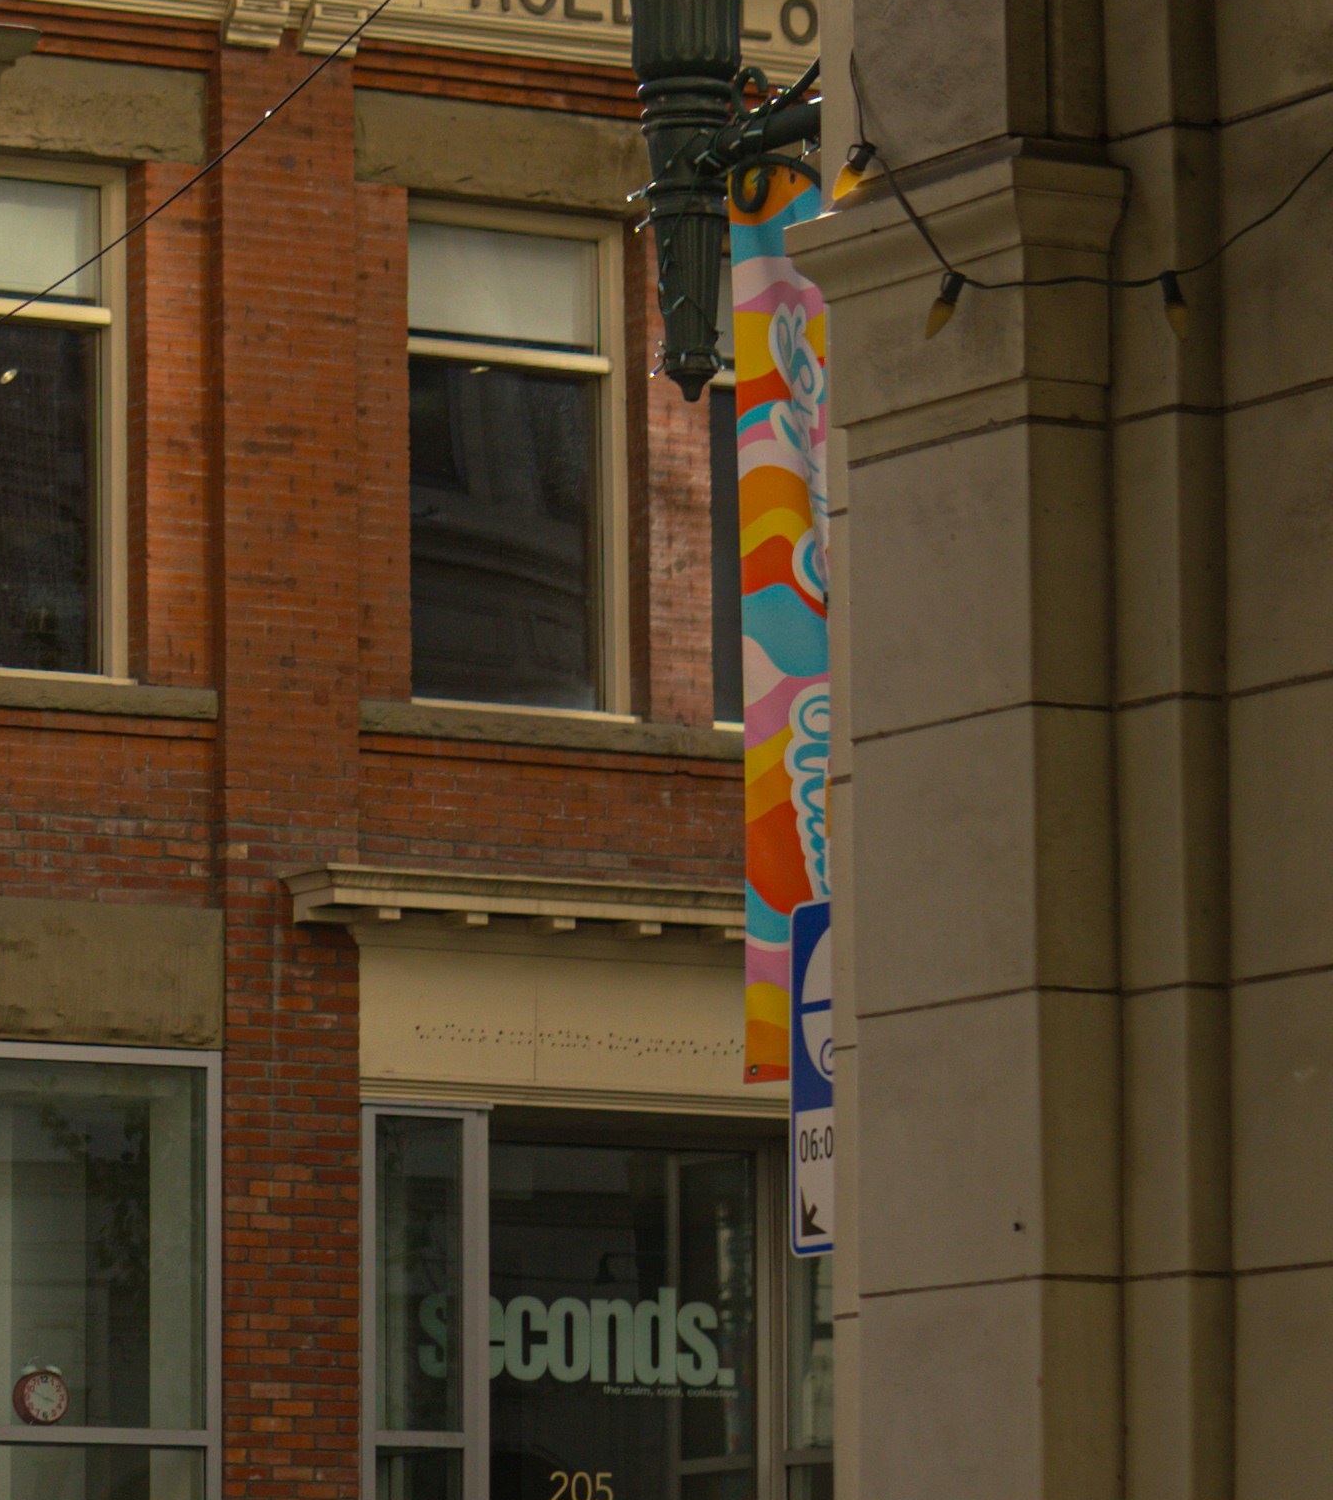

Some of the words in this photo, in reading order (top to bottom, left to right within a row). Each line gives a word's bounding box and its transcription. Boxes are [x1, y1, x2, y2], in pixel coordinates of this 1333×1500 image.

[800, 1125, 833, 1163] 06:0
[603, 1385, 621, 1396] the
[623, 1385, 654, 1397] calm,
